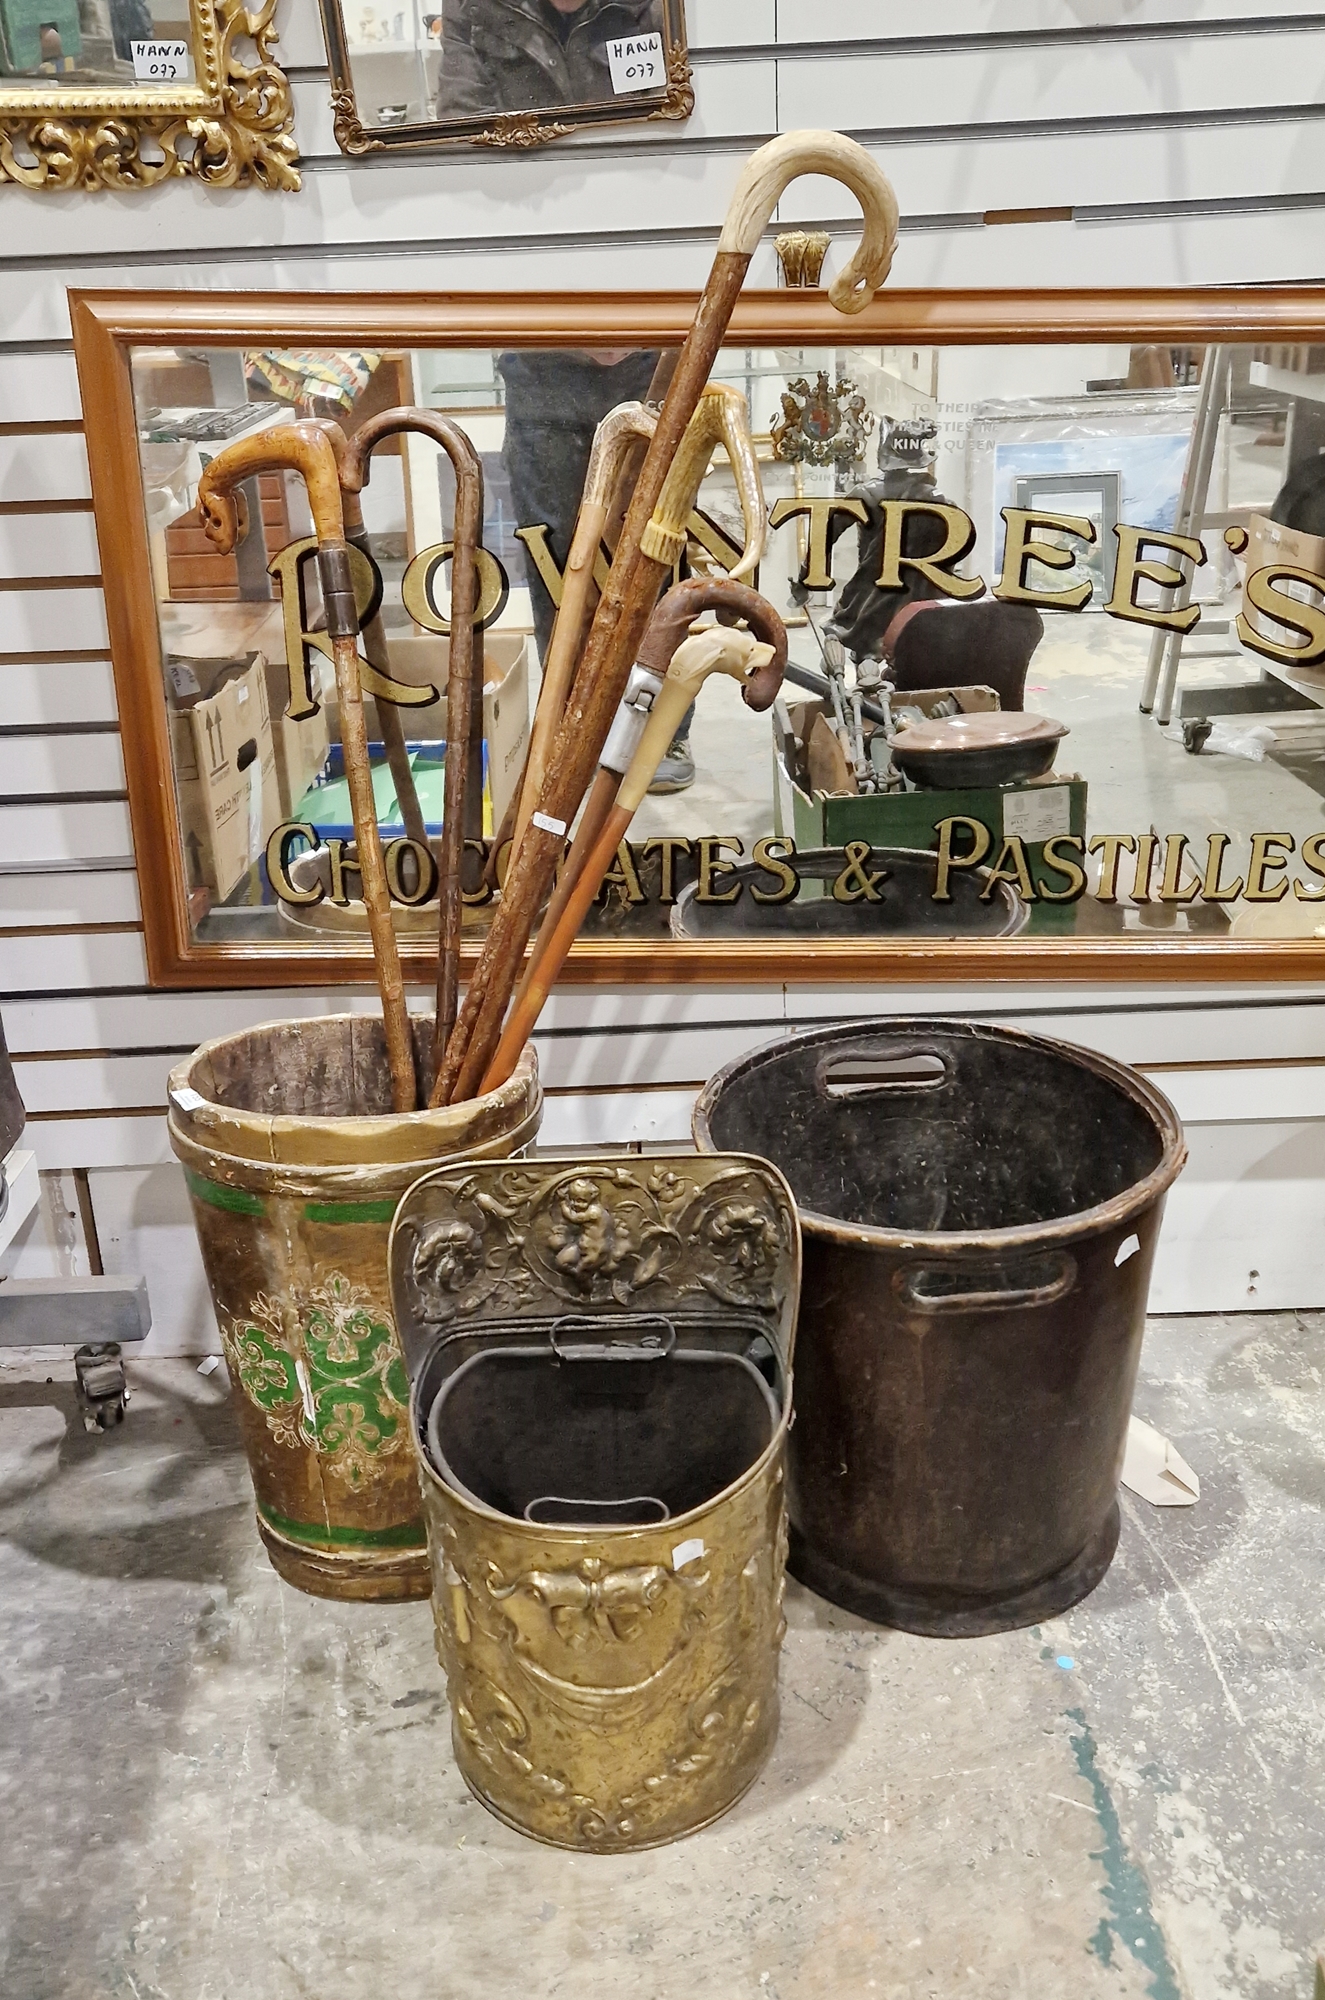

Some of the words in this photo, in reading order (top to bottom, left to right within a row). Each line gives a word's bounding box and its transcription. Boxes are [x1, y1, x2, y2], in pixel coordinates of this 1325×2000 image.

[136, 44, 185, 56] HANN
[612, 37, 658, 58] HANN
[149, 63, 177, 78] 077
[625, 62, 655, 78] 077
[911, 403, 930, 413] TO
[937, 403, 981, 414] THEIR
[894, 438, 930, 450] KING
[944, 439, 996, 454] QUEEN
[266, 822, 800, 906] CHOCATES
[833, 840, 892, 905] &
[932, 814, 1325, 903] PASTILLES
